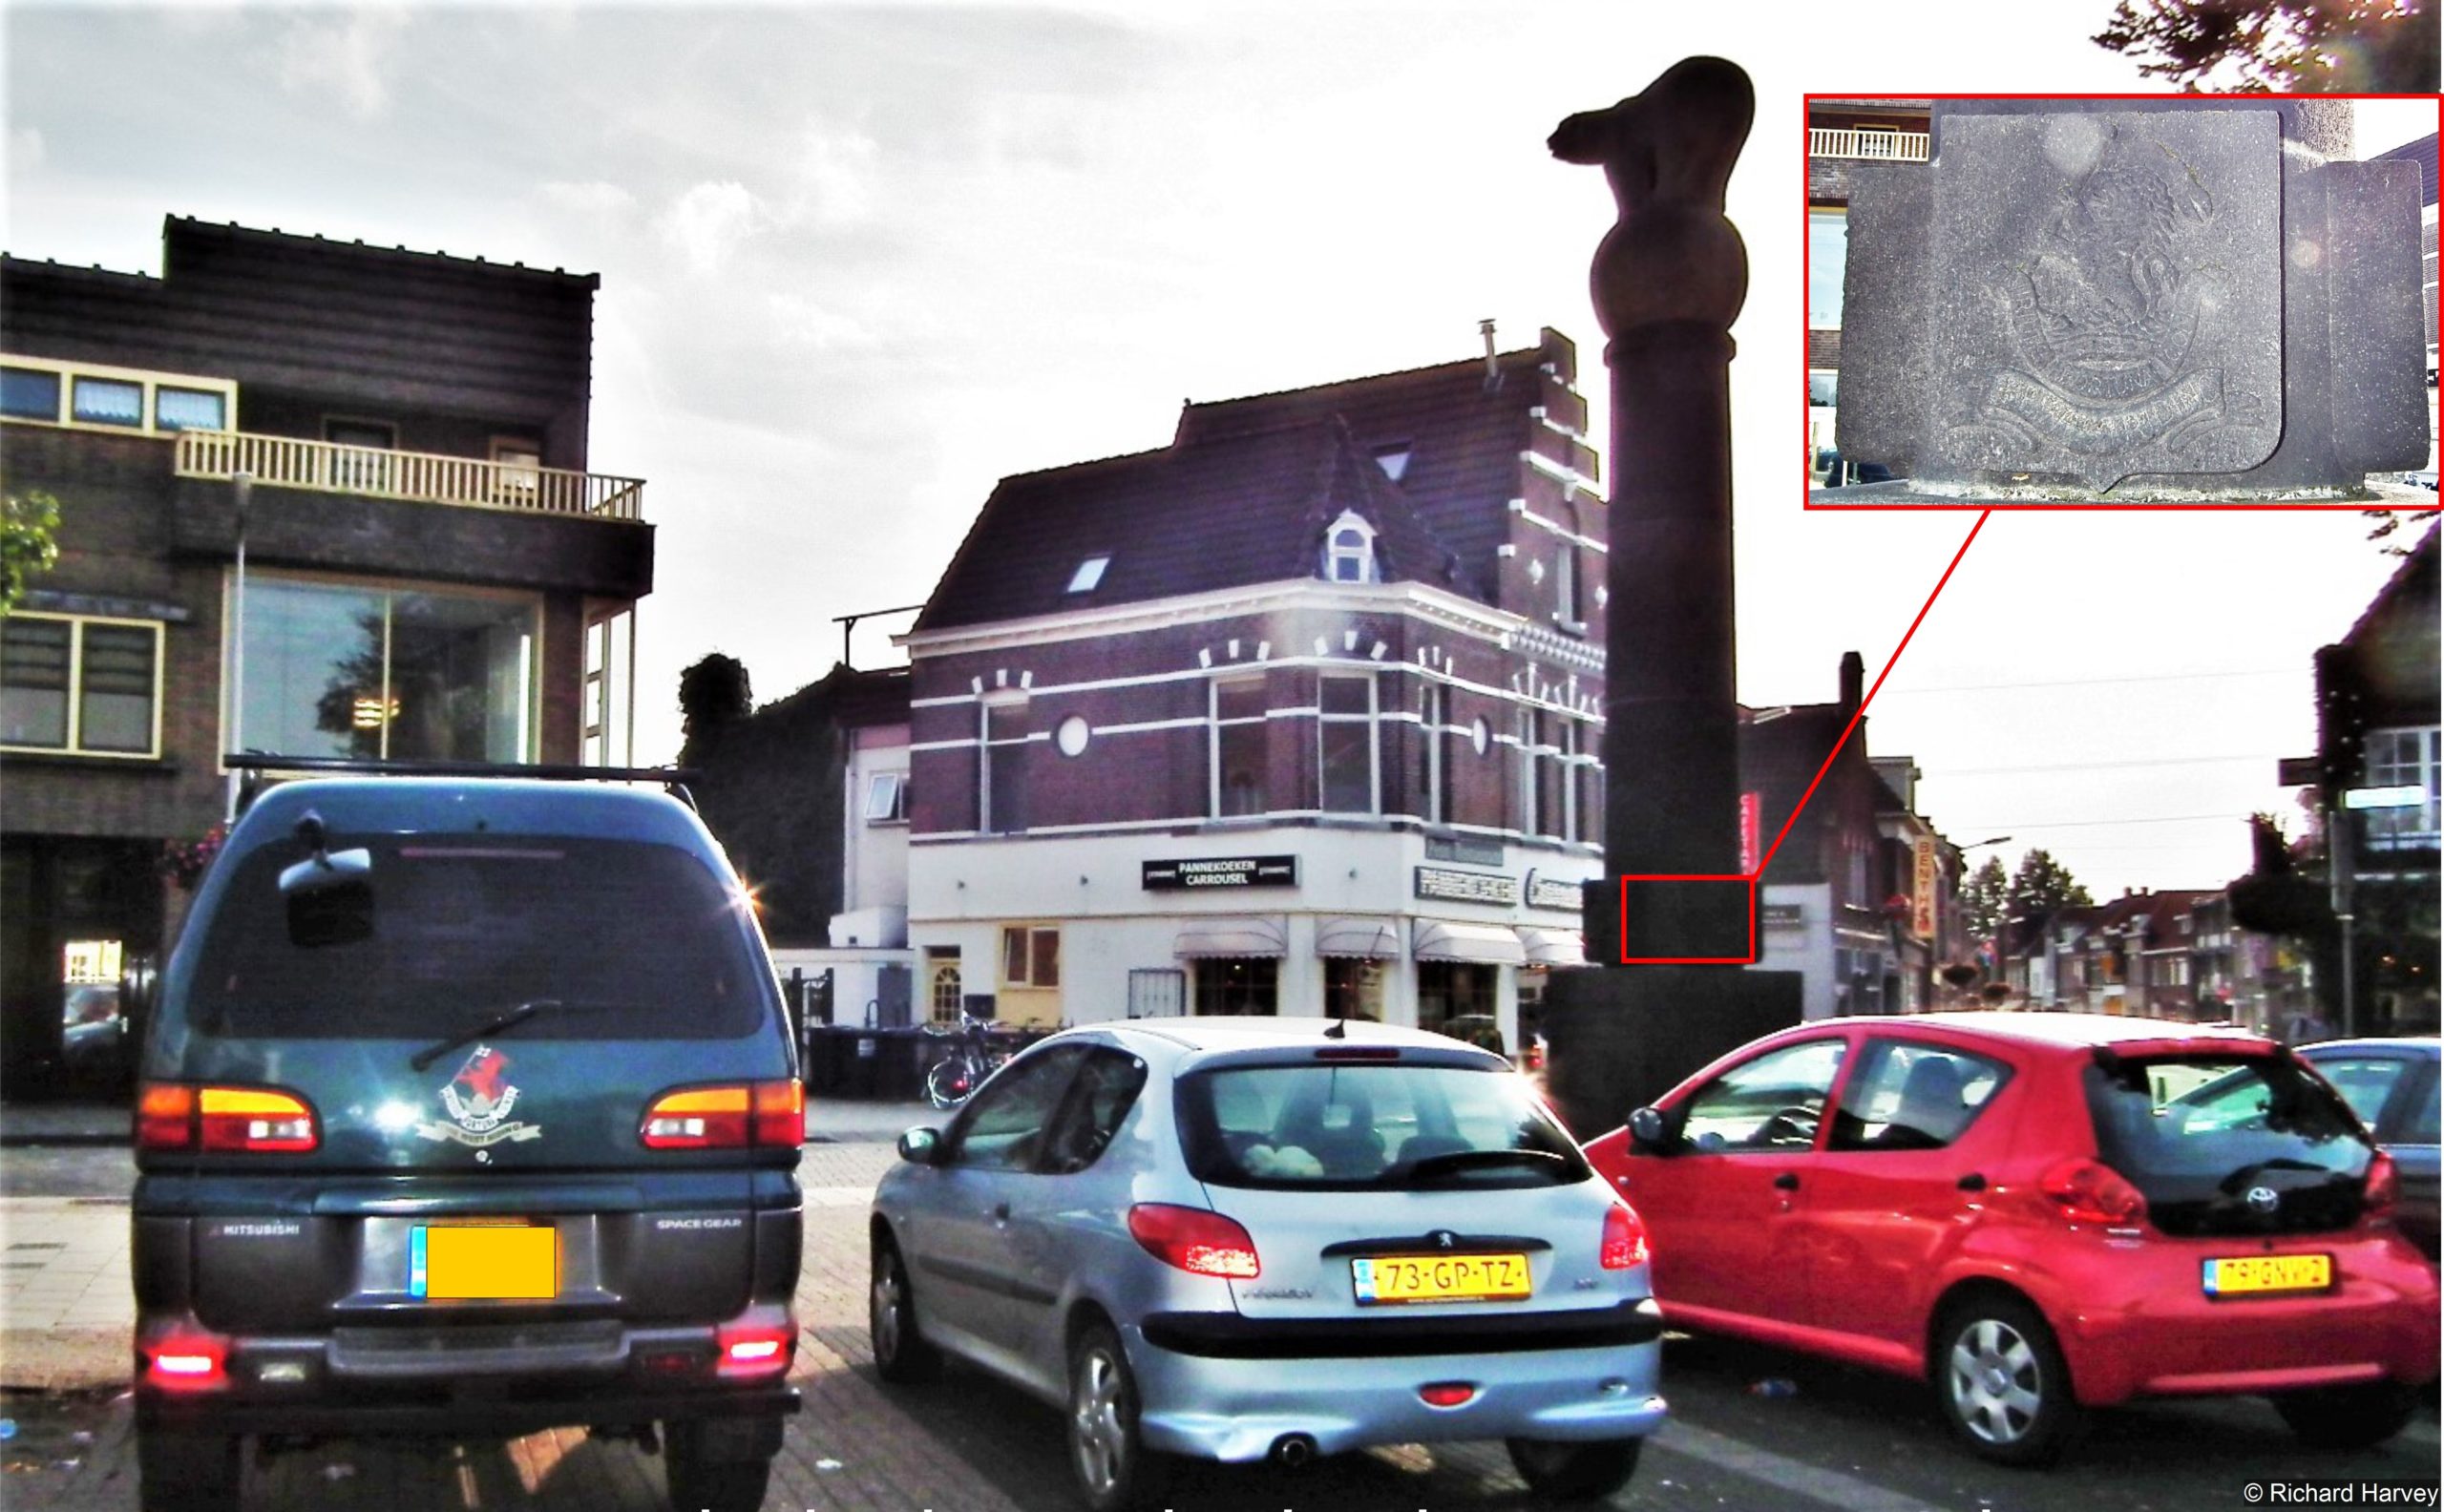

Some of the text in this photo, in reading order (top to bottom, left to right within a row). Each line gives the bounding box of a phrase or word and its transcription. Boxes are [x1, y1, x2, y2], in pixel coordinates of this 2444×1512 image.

[1178, 861, 1256, 873] PANNEKOEKEN
[1186, 873, 1249, 886] CARROUSEL
[657, 1218, 742, 1229] SPACE GEAR
[223, 1225, 300, 1235] MITSUBISHI
[1387, 1261, 1515, 1292] 73-GP-TZ
